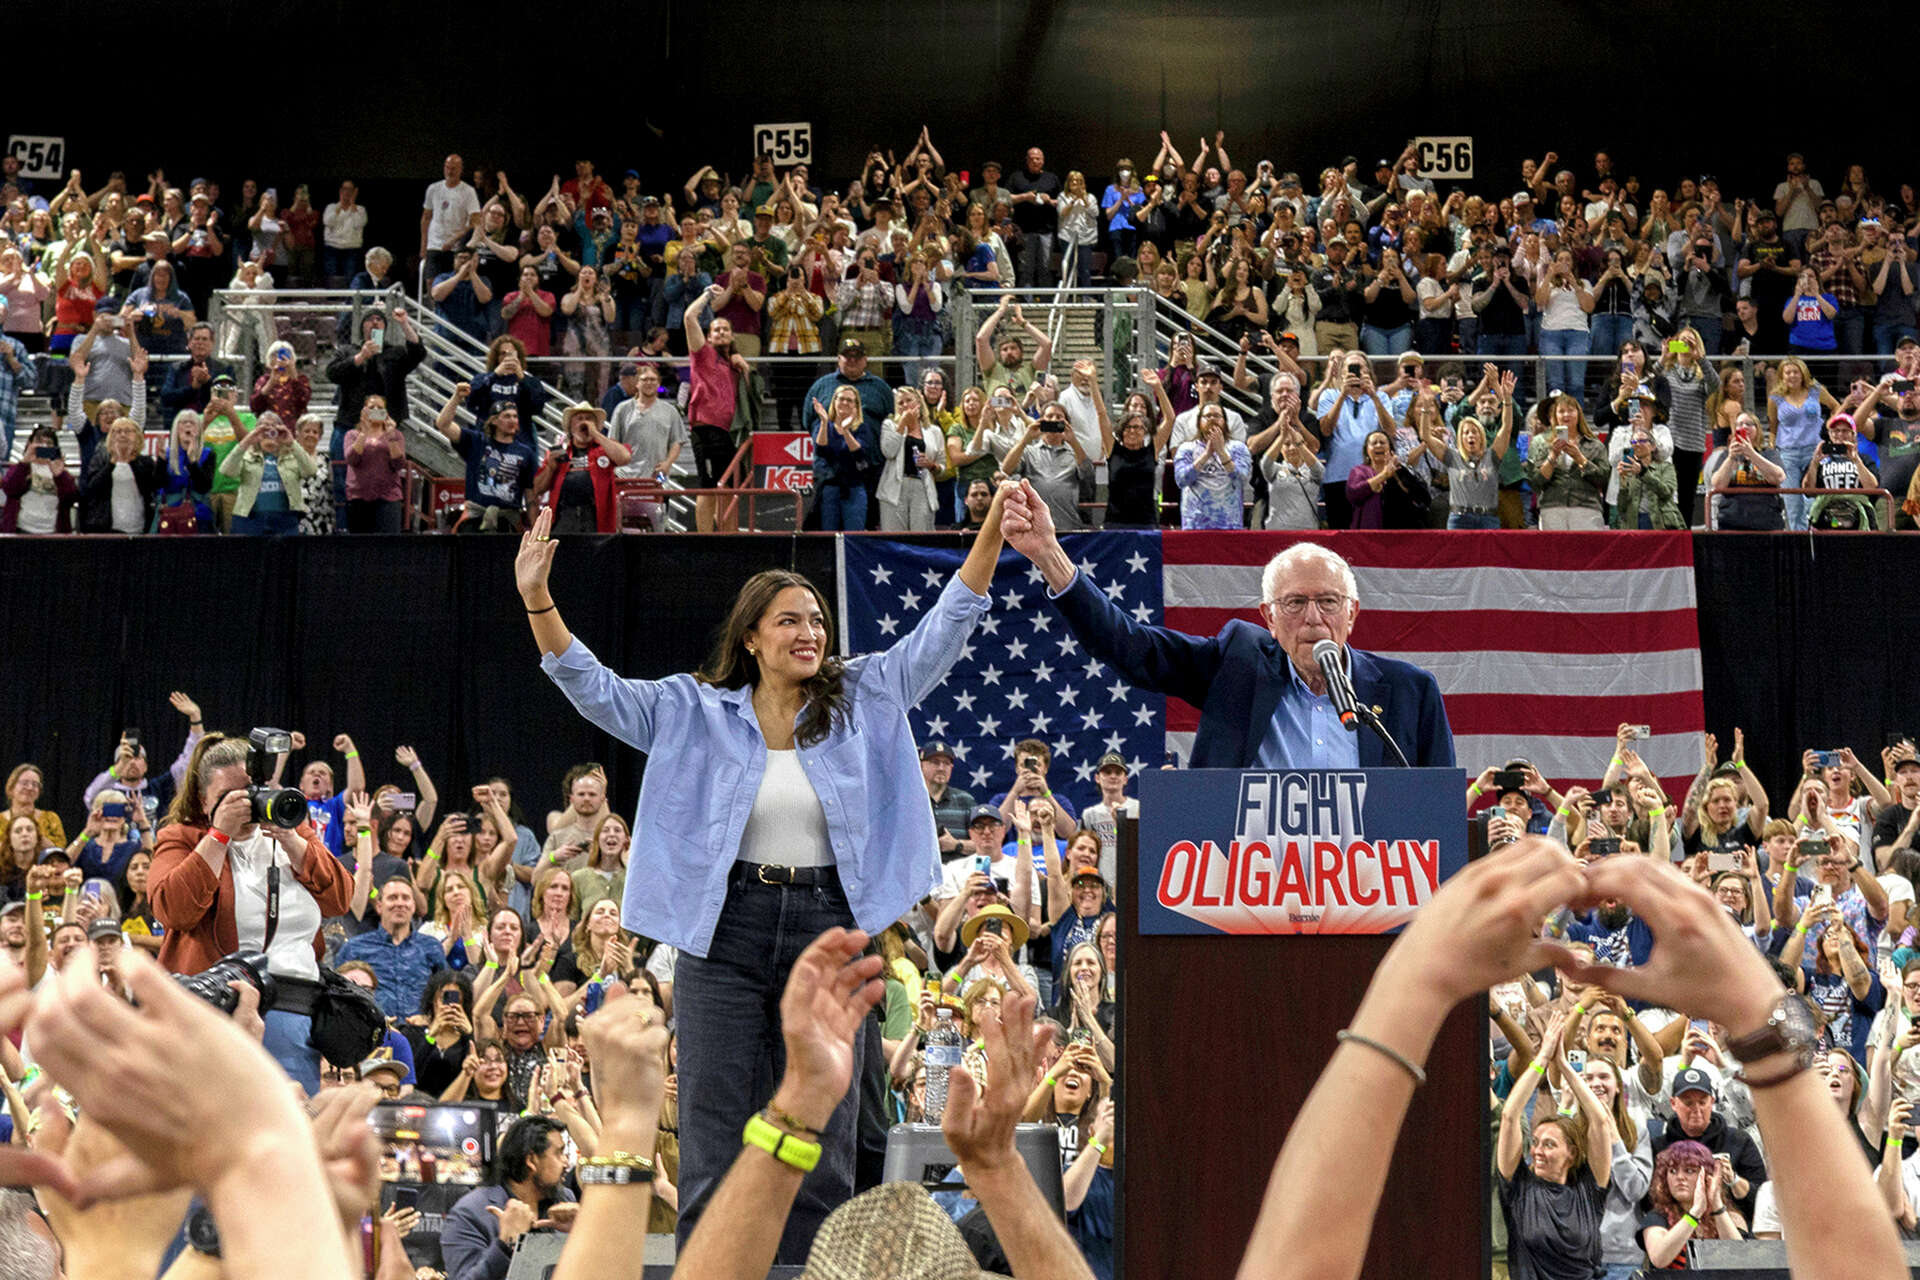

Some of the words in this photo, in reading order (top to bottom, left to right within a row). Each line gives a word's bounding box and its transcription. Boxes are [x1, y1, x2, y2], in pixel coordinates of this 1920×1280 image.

[10, 140, 62, 173] C54
[757, 129, 810, 160] C55
[1418, 142, 1471, 173] C56
[1235, 773, 1367, 837] FIGHT
[1156, 839, 1440, 907] OLIGARCHY
[1288, 911, 1321, 922] Bernie
